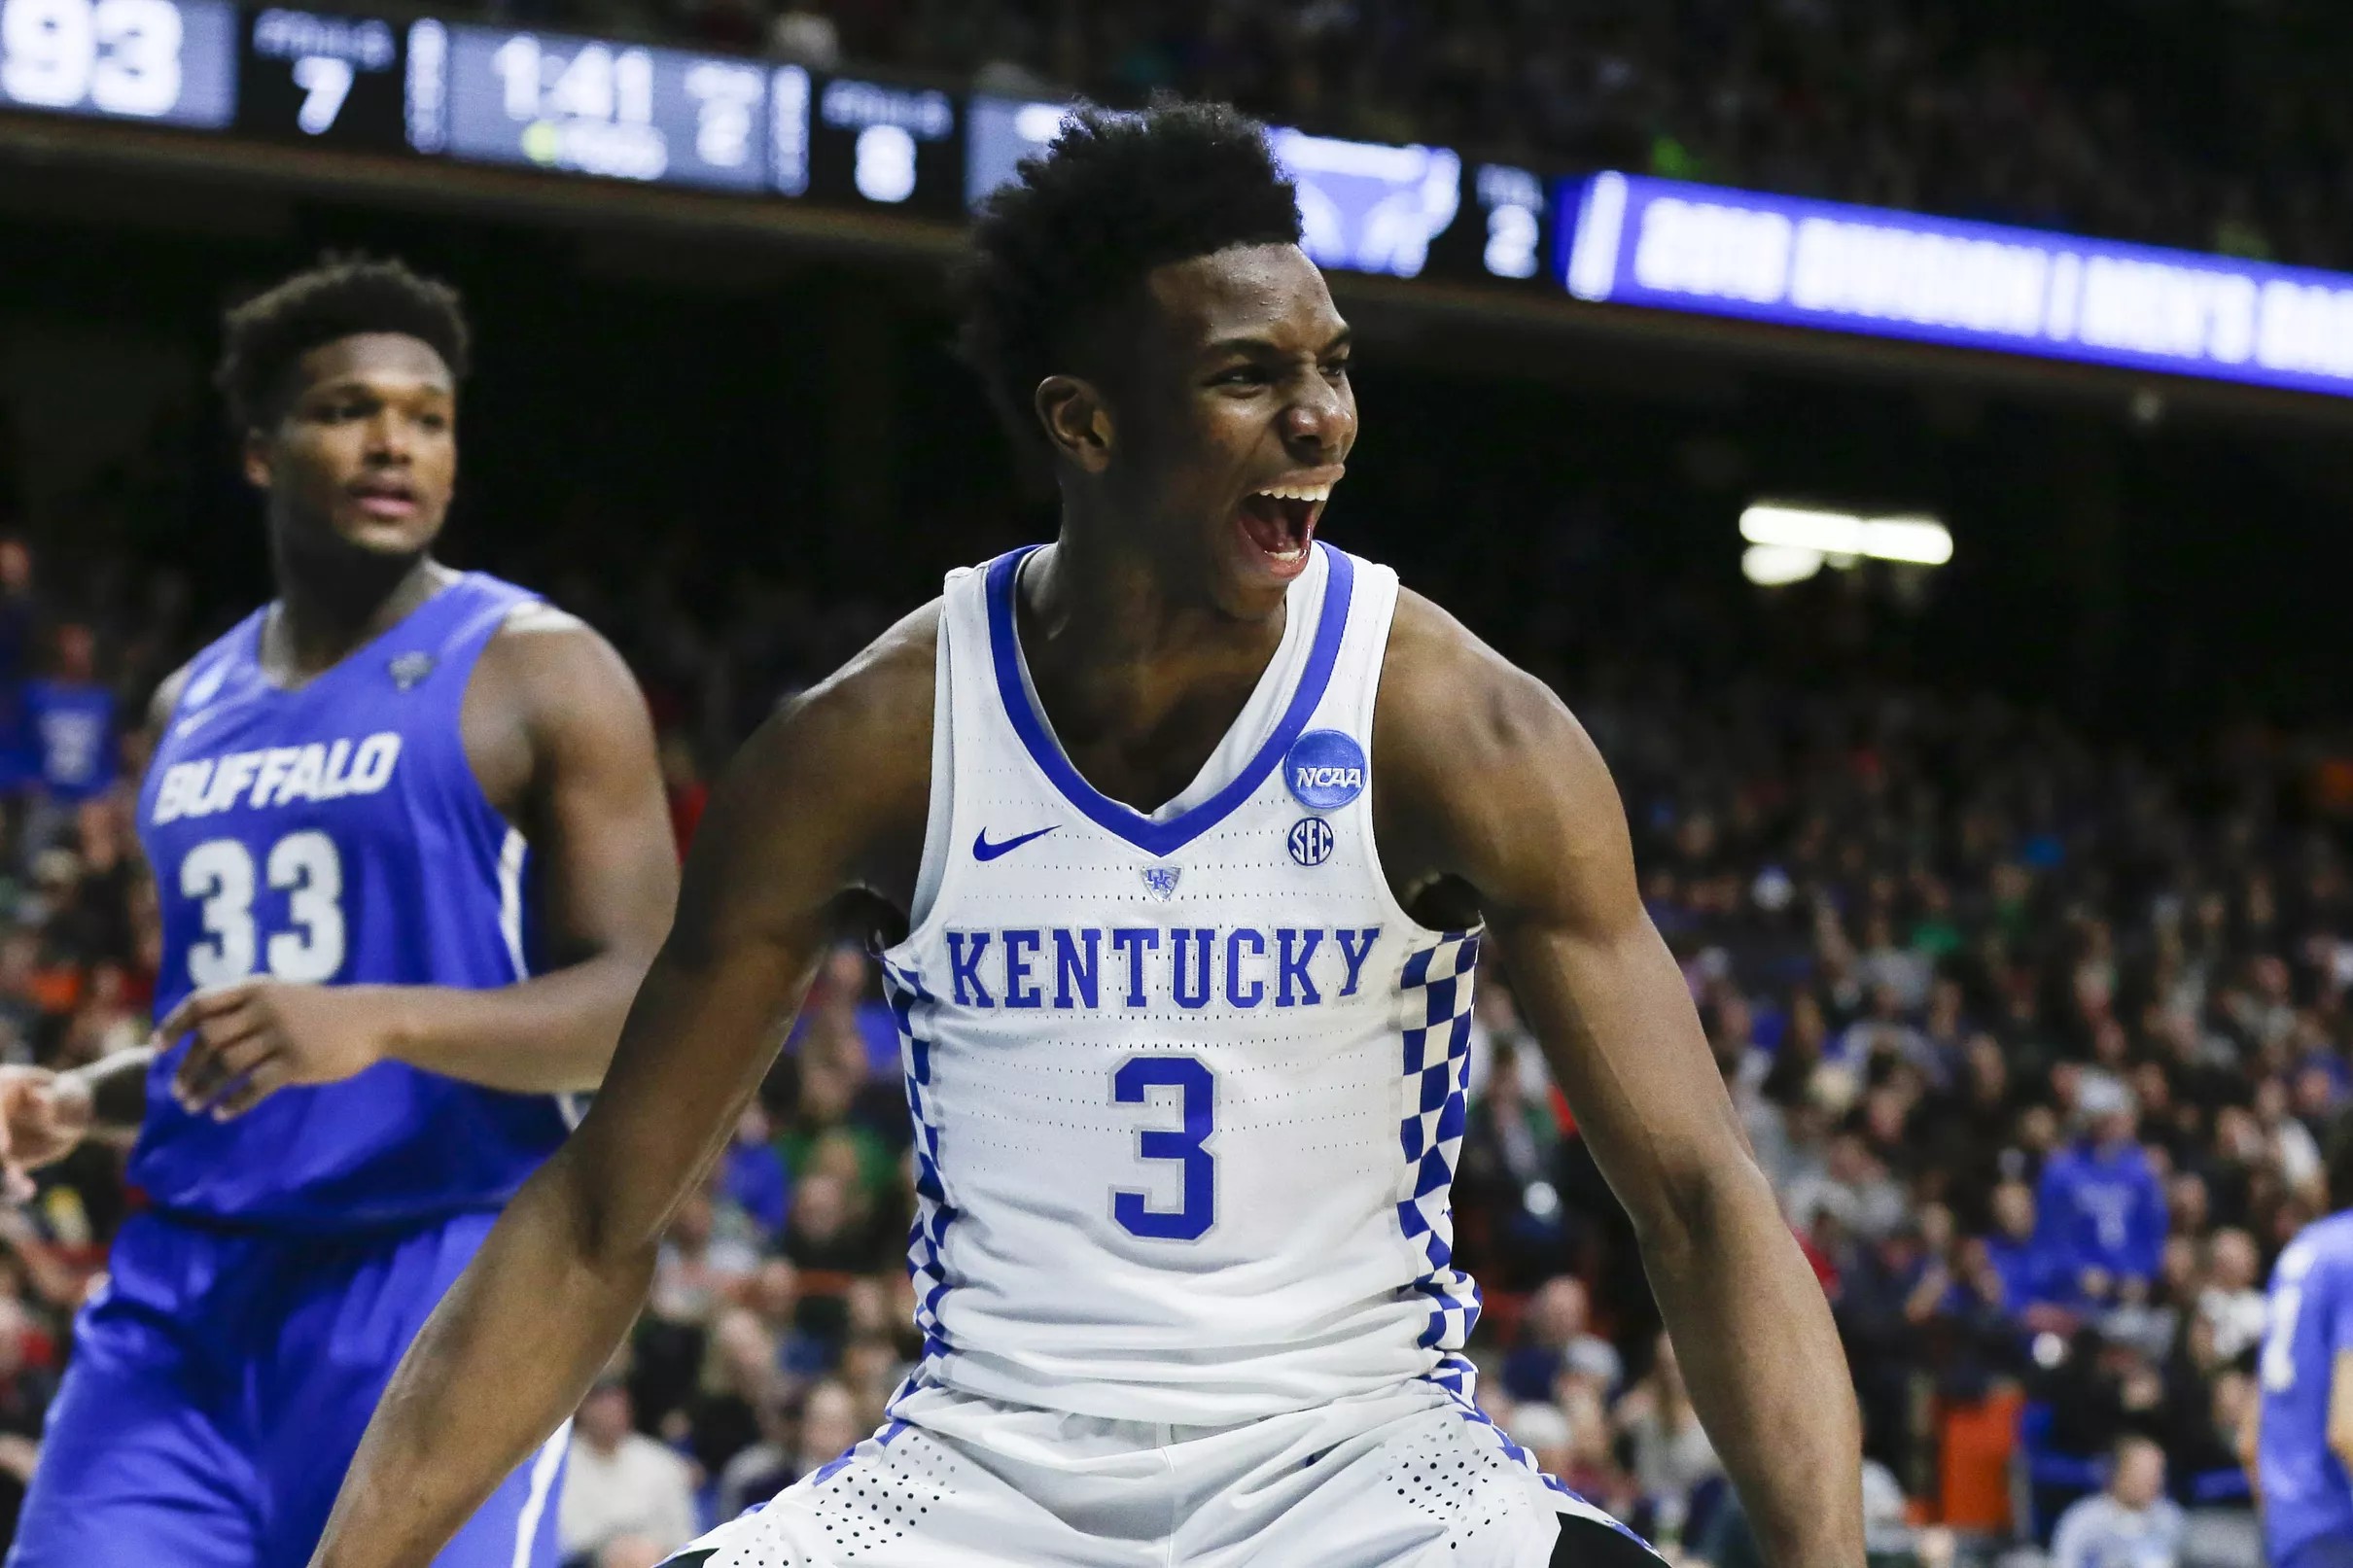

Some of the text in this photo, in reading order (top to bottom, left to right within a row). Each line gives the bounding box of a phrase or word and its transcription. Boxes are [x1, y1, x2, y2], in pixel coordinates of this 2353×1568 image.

[2, 0, 183, 116] 93
[294, 56, 354, 134] 7
[154, 732, 401, 825] BUFFALO
[1296, 768, 1361, 788] NCAA
[1291, 819, 1331, 864] SEC
[182, 830, 344, 994] 33
[946, 927, 1381, 1009] KENTUCKY
[1111, 1055, 1219, 1245] 3
